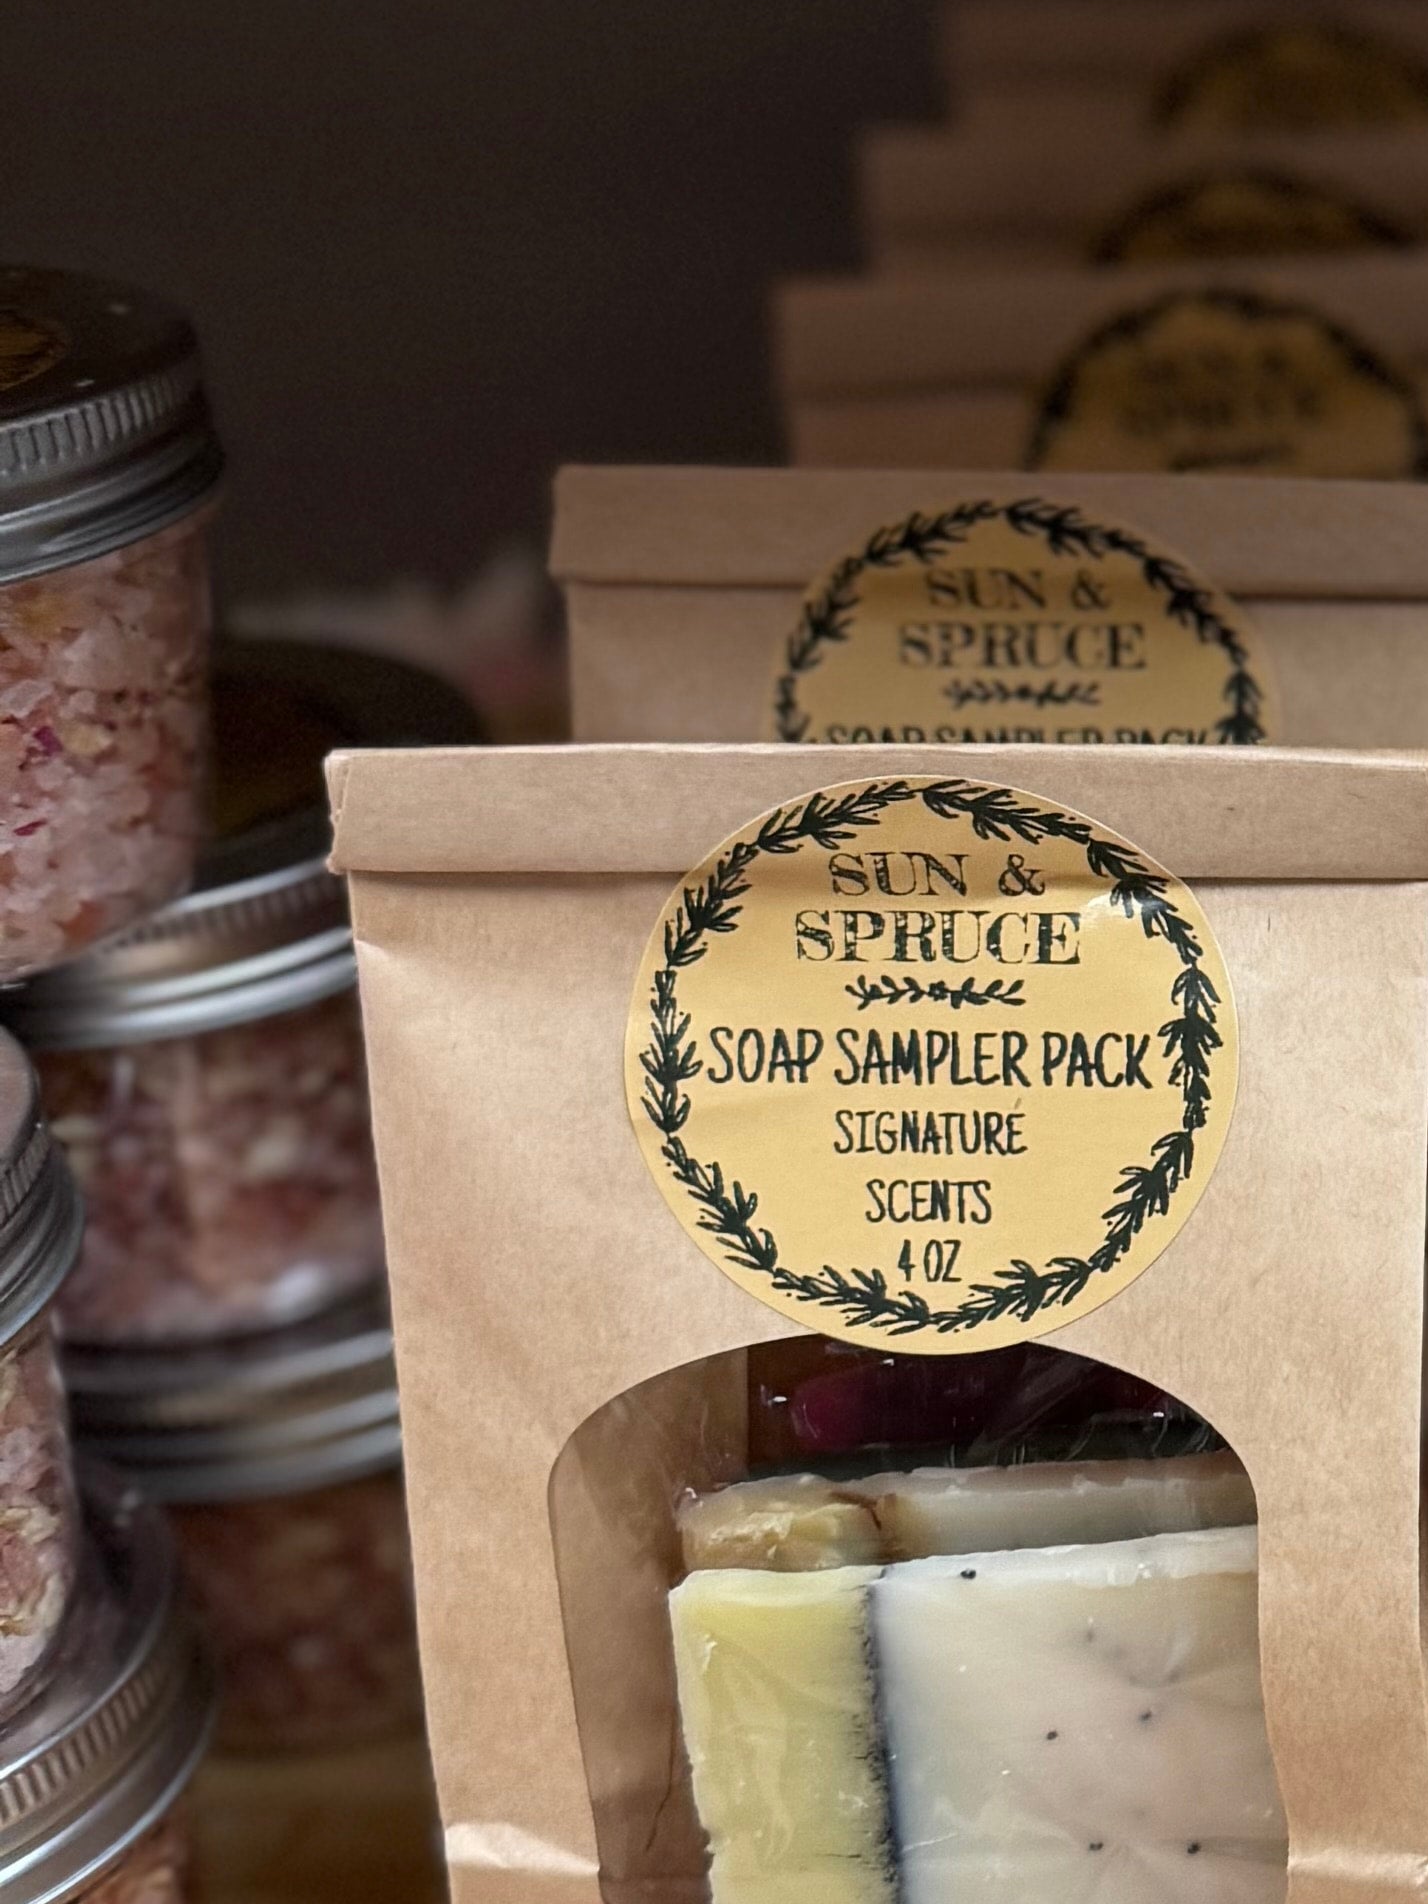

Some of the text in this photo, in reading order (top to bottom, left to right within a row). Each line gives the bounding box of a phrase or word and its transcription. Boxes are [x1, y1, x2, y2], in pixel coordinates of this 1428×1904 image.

[925, 568, 1110, 611] SUN &
[899, 620, 1147, 670] SPRUCE
[829, 851, 1047, 897] SUN &
[795, 910, 1081, 965] SPRUCE
[707, 1027, 1153, 1089] SOAP SAMPLER PACK
[834, 1110, 1028, 1156] SIGNATURE
[865, 1179, 992, 1224] SCENTS
[897, 1239, 962, 1282] 4 OZ
